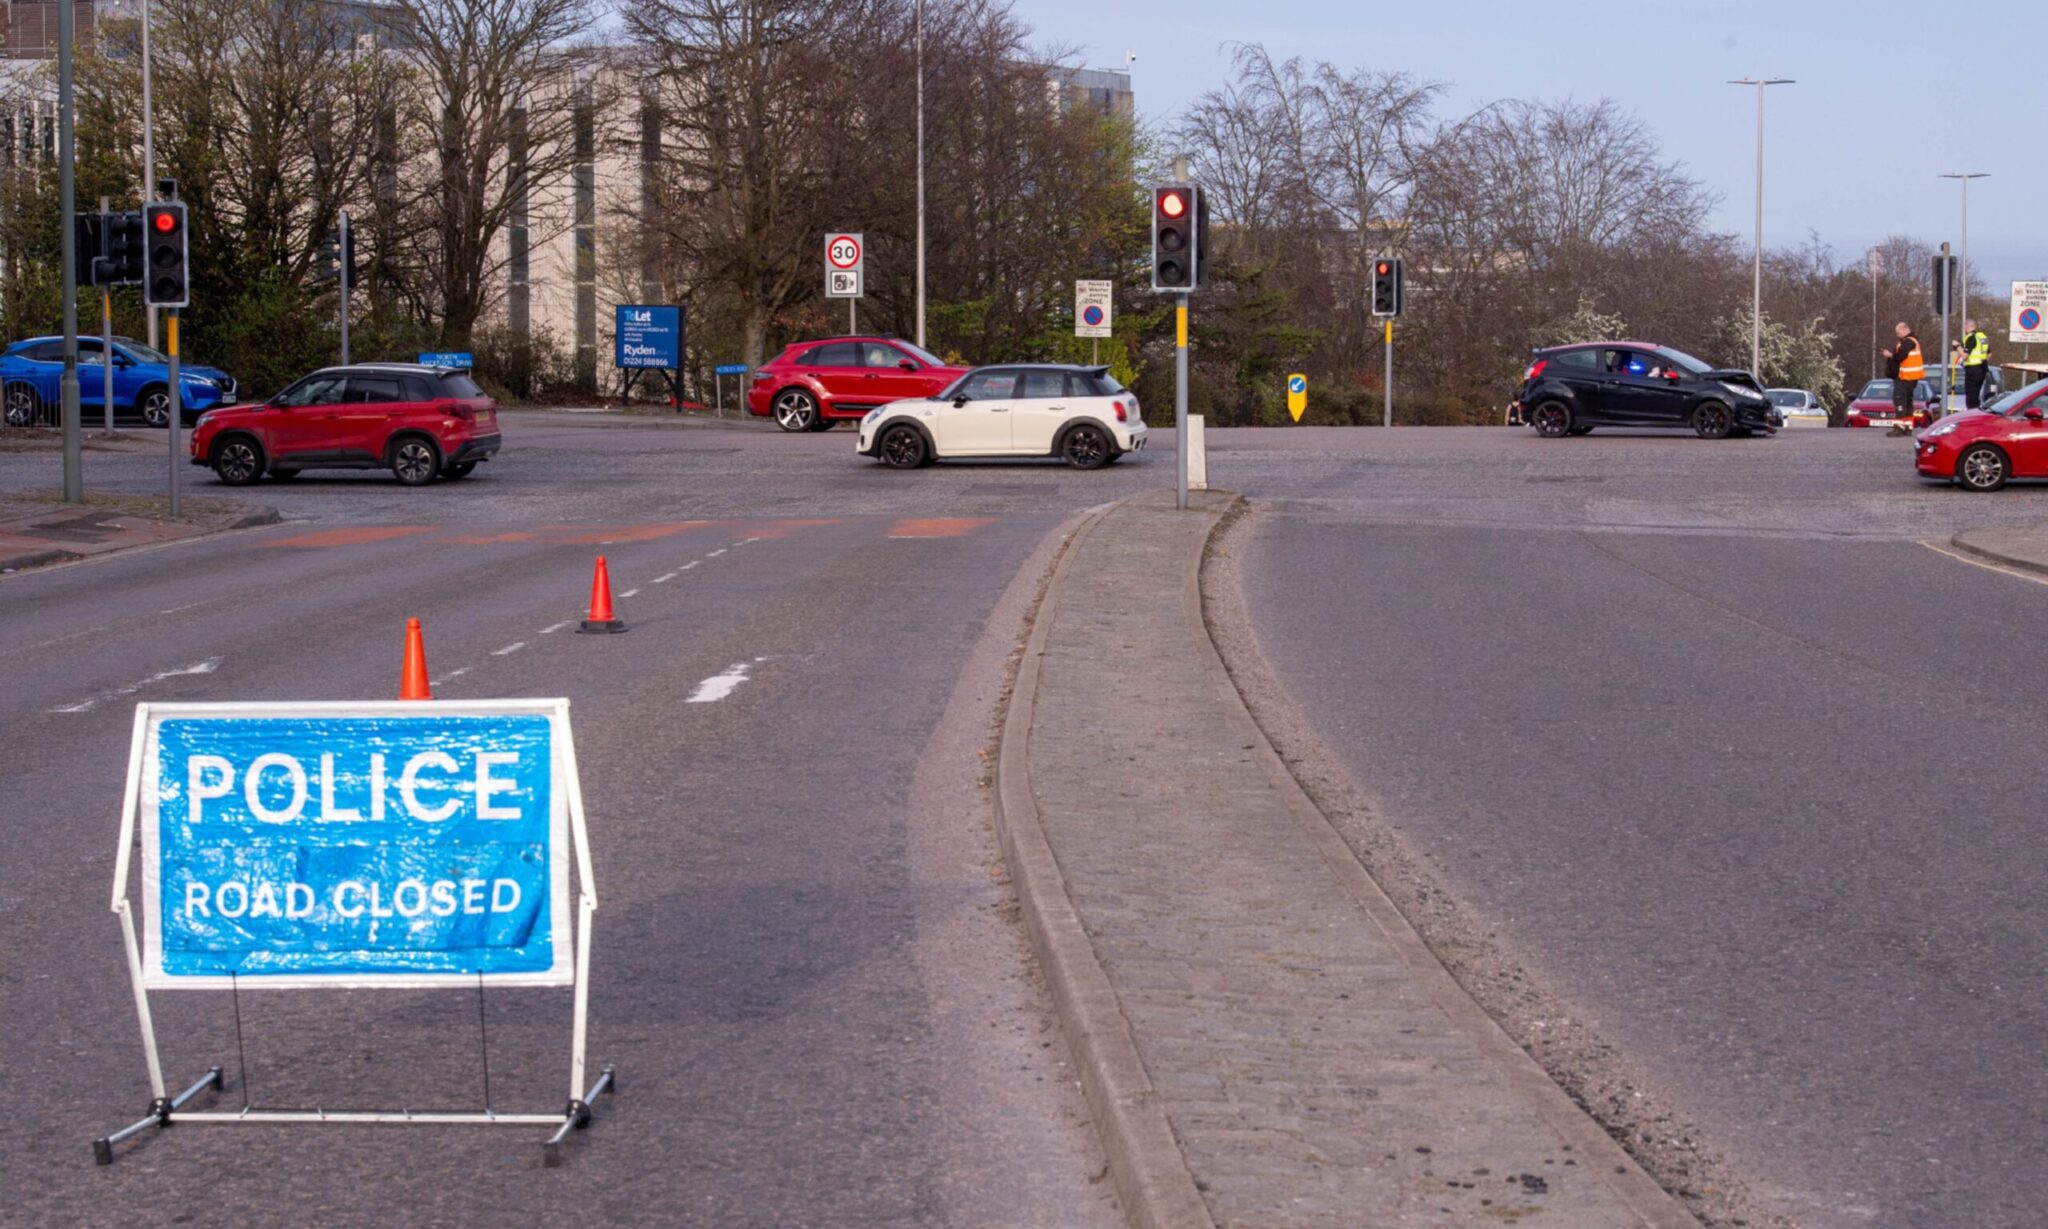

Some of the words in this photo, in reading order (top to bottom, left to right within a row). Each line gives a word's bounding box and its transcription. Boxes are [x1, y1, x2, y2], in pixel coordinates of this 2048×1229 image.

[833, 246, 855, 259] 30
[187, 751, 522, 824] POLICE
[184, 881, 316, 919] ROAD
[333, 878, 522, 918] CLOSED
